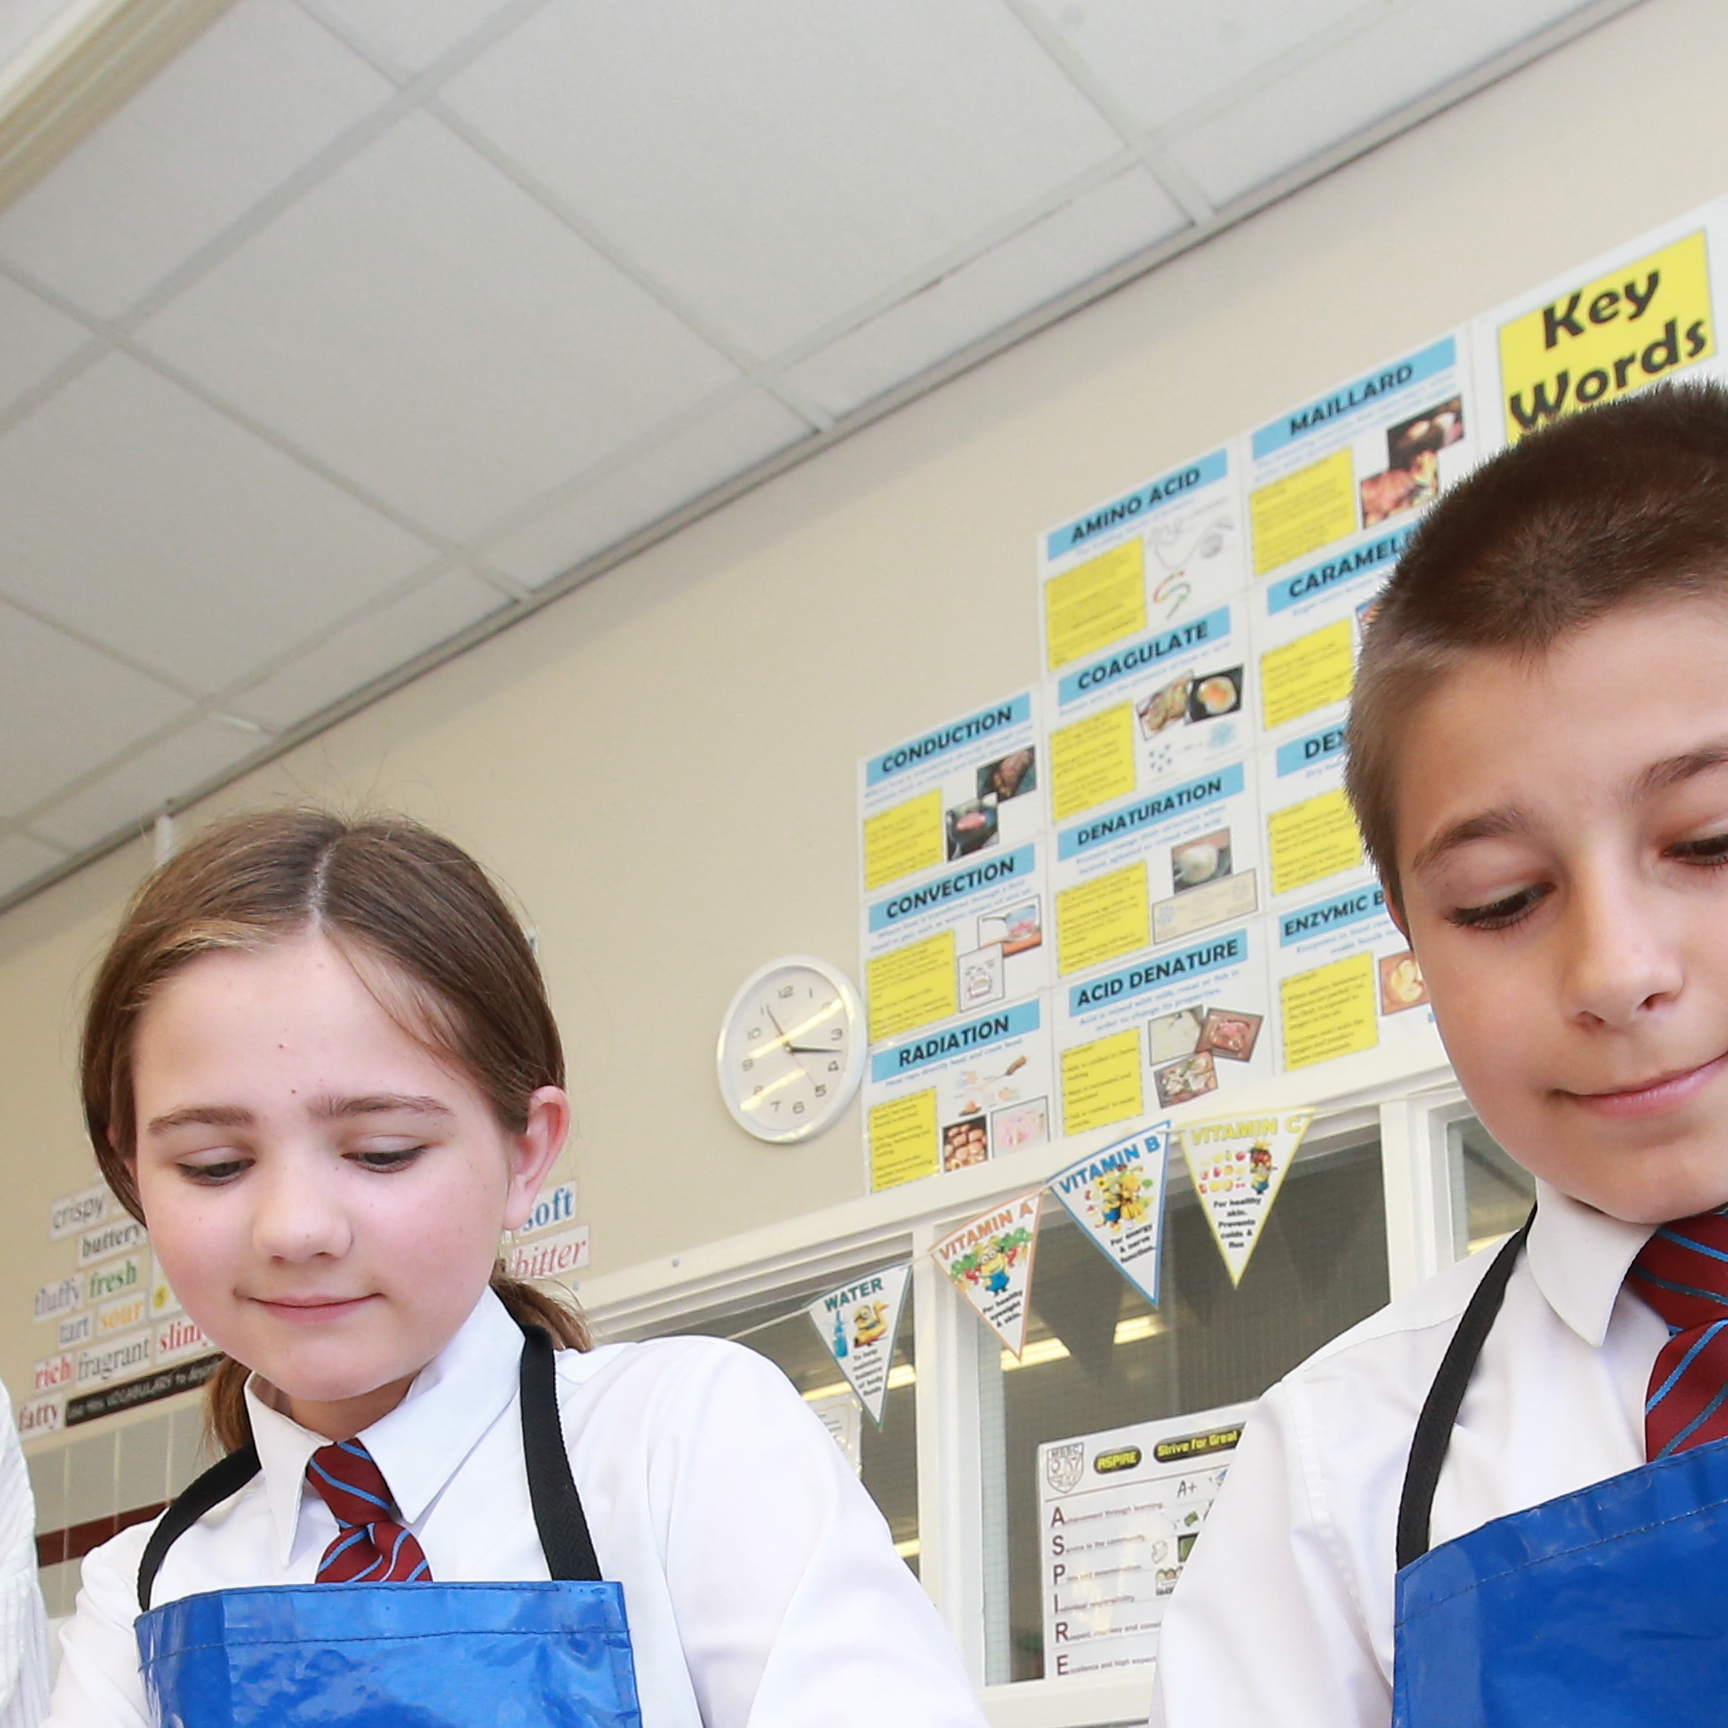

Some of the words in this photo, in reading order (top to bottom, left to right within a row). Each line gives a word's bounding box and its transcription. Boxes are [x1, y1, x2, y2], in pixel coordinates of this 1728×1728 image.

[1542, 268, 1660, 352] Key
[1509, 316, 1707, 432] Words
[1290, 364, 1413, 437] MAILLARD
[1071, 499, 1141, 545] AMINO
[1148, 467, 1200, 508] ACID
[1289, 532, 1410, 599] CARAMEL
[1078, 620, 1208, 690] COAGULATE
[882, 706, 1012, 773] CONDUCTION
[1304, 730, 1344, 759] DEX
[1077, 777, 1222, 846] DENATURATION
[887, 857, 1014, 918] CONVECTION
[1284, 895, 1367, 936] ENZYMIC
[779, 985, 794, 999] 12
[1077, 978, 1123, 1008] ACID
[1129, 939, 1239, 990] DENATURE
[899, 1015, 1009, 1067] RADIATION
[827, 1060, 839, 1073] 4
[792, 1101, 805, 1114] 6
[815, 1084, 827, 1097] 5
[1192, 1119, 1278, 1146] VITAMIN
[1285, 1116, 1301, 1134] C
[1059, 1144, 1141, 1194] VITAMIN
[1144, 1135, 1161, 1153] B
[53, 1191, 104, 1230] crispy
[81, 1222, 141, 1258] buttery
[937, 1210, 1014, 1263] VITAMIN
[1018, 1200, 1034, 1217] A
[89, 1259, 137, 1299] fresh
[515, 1240, 586, 1281] bitter
[34, 1278, 80, 1317] fluffy
[101, 1301, 144, 1330] sour
[825, 1277, 884, 1313] WATER
[60, 1315, 91, 1344] tart
[35, 1355, 72, 1389] rich
[77, 1337, 150, 1381] fragrant
[19, 1402, 58, 1431] fatty
